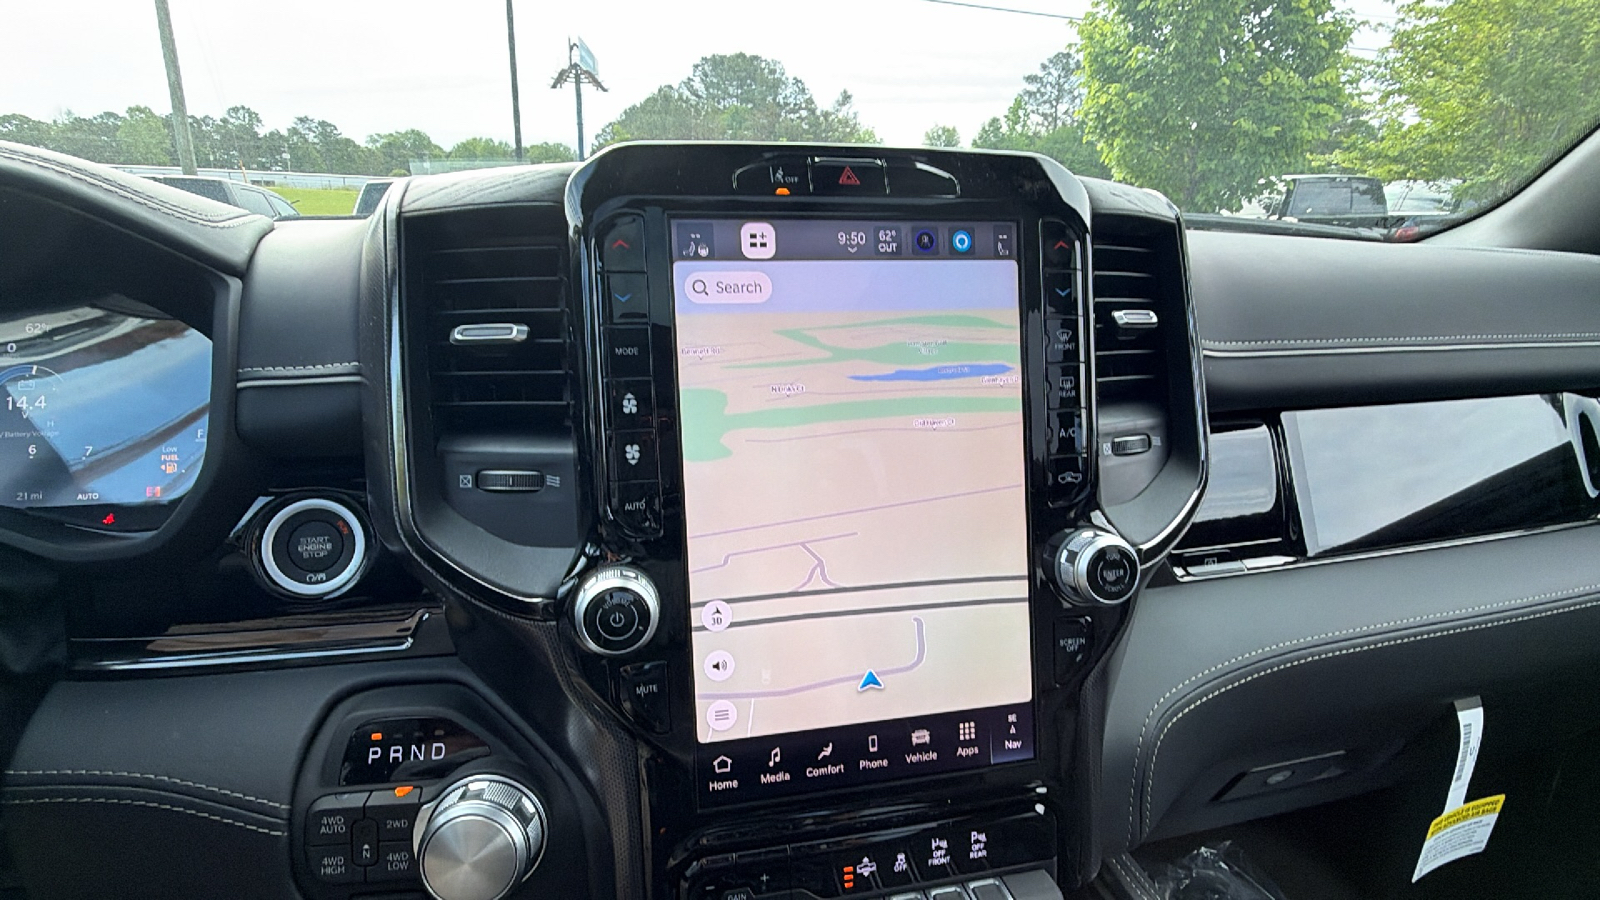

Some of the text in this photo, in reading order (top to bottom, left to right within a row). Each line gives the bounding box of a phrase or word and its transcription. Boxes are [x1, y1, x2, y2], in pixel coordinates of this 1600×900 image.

[837, 231, 866, 245] 9:50
[878, 242, 898, 253] OUT
[715, 280, 763, 295] Search
[7, 342, 16, 352] 0
[614, 347, 639, 356] MODE
[1054, 342, 1076, 350] FRONT
[1058, 389, 1076, 398] REAR
[6, 394, 47, 411] 14.4
[21, 410, 29, 419] V
[197, 429, 204, 439] F
[1059, 428, 1077, 438] A/C
[28, 444, 37, 455] 6
[84, 446, 93, 457] 7
[16, 490, 43, 501] 21 mi
[76, 492, 99, 501] AUTO
[624, 499, 646, 511] AUTO
[299, 536, 330, 544] START
[297, 543, 333, 552] ENGINE
[302, 550, 328, 558] STOP
[1102, 569, 1125, 578] ENTER
[710, 616, 723, 626] 3D
[1059, 637, 1086, 648] SCREEN
[1066, 644, 1079, 652] OFF
[635, 684, 659, 697] MUTE
[1004, 739, 1023, 750] Nav
[368, 742, 446, 765] P R N D
[904, 750, 938, 764] Vehicle
[956, 745, 979, 758] Apps
[859, 758, 889, 771] Phone
[805, 764, 845, 778] Comfort
[760, 771, 791, 784] Media
[708, 779, 739, 792] Home
[321, 816, 345, 826] 4WD
[386, 819, 408, 829] 2WD
[319, 824, 346, 835] AUTO
[972, 843, 985, 852] OFF
[362, 848, 371, 860] N
[386, 852, 409, 862] 4WD
[932, 850, 946, 858] OFF
[969, 850, 987, 860] REAR
[321, 856, 345, 866] 4WD
[387, 861, 409, 871] LOW
[928, 855, 951, 867] FRONT
[320, 865, 345, 876] HIGH
[893, 862, 908, 873] OFF
